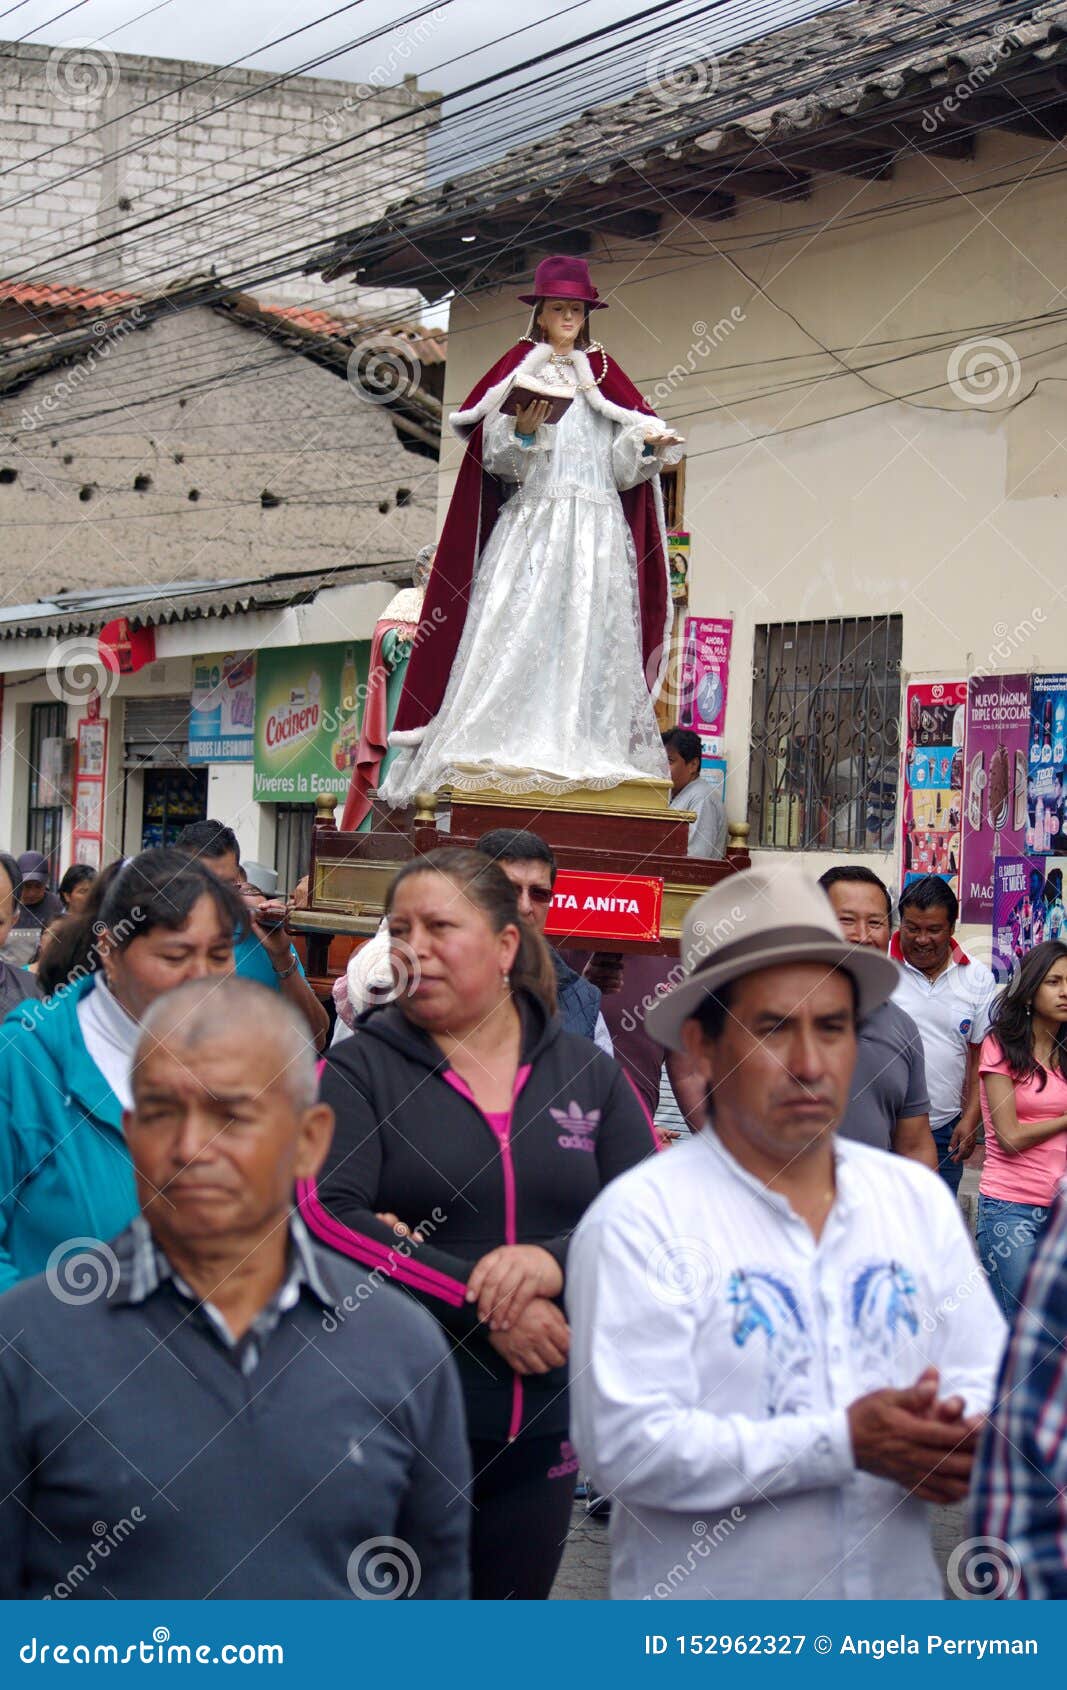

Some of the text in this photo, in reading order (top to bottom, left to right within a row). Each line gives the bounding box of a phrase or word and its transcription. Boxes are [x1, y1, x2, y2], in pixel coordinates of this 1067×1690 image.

[975, 691, 1028, 708] NUEVO MAGNUM
[971, 705, 1030, 721] TRIPLE CHOCOLATE
[266, 704, 319, 747] Cocinero
[255, 774, 295, 793] Viveres
[297, 773, 308, 792] la
[970, 883, 994, 899] MAG
[1002, 877, 1009, 892] TE
[583, 896, 640, 914] ANITA
